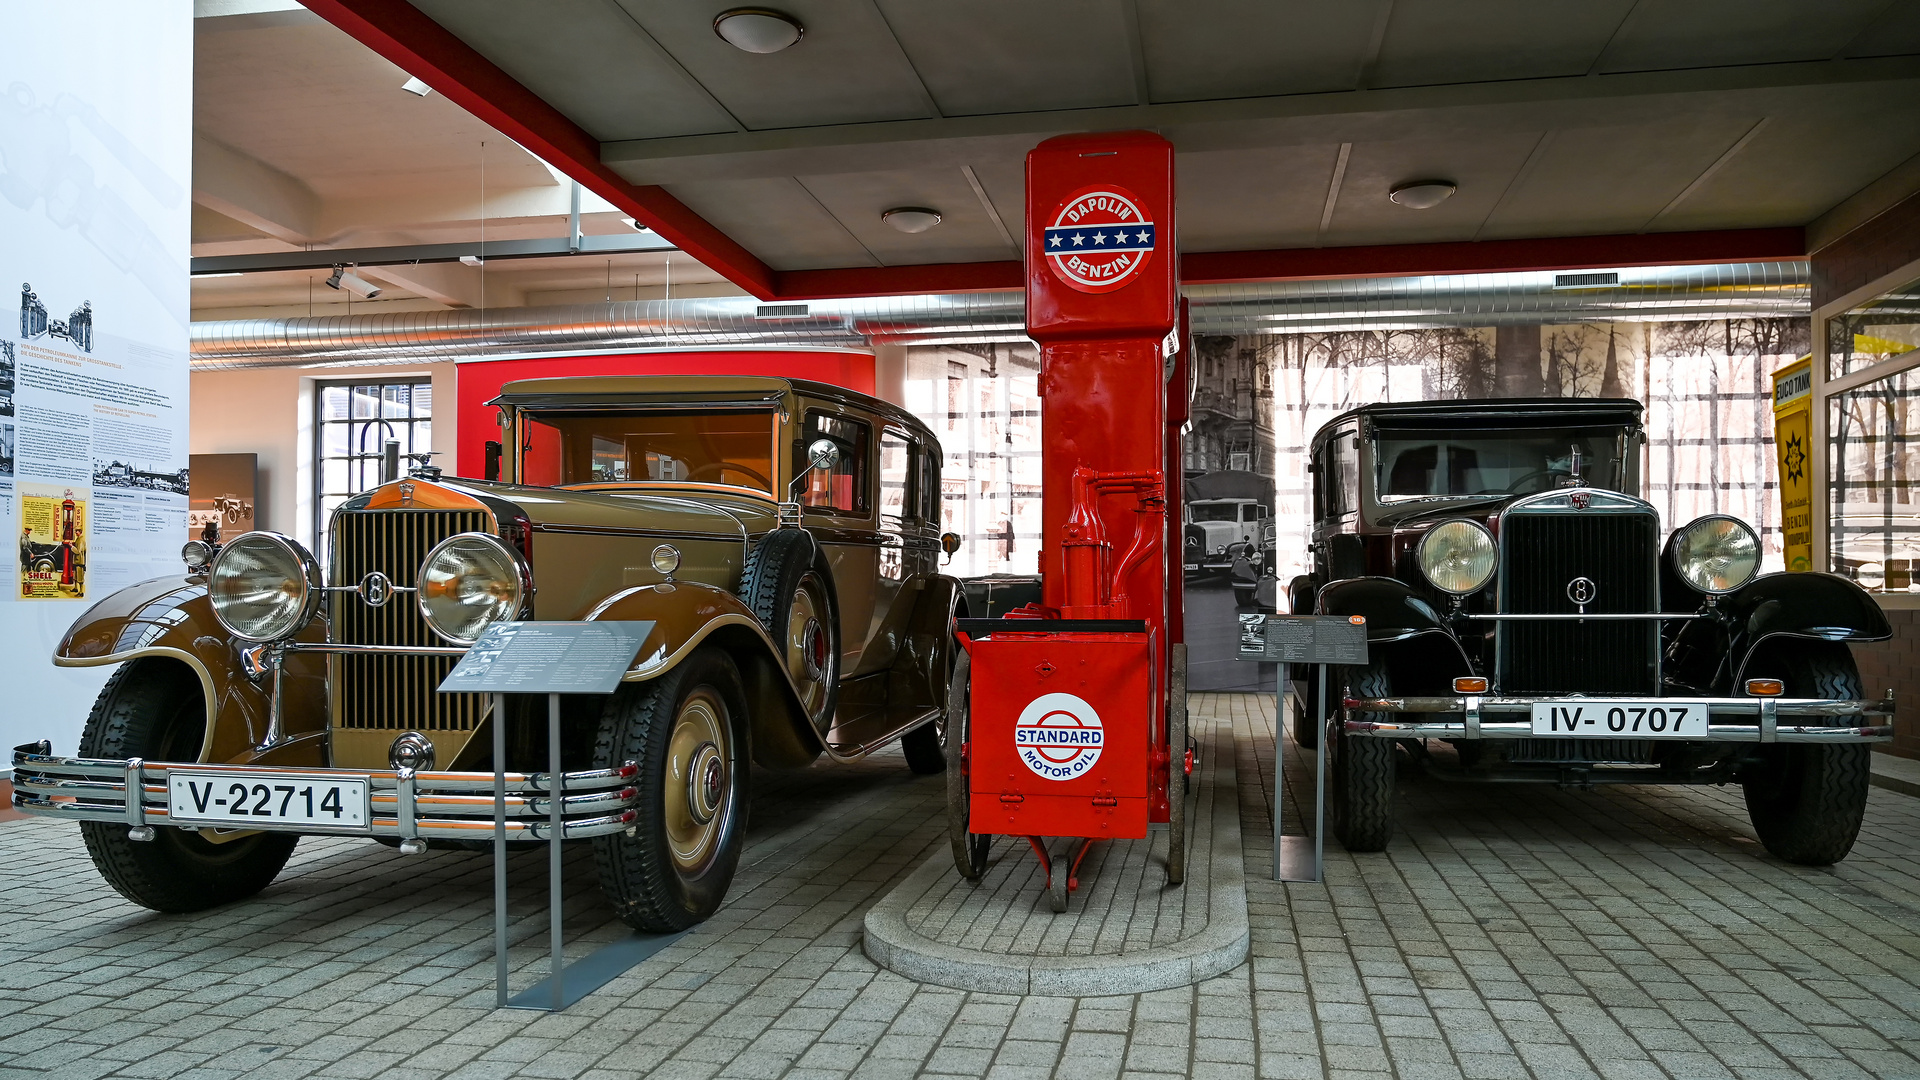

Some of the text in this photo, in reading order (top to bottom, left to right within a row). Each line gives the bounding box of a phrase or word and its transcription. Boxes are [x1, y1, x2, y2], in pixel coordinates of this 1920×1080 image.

[1067, 197, 1133, 223] DAPOLIN
[1067, 253, 1131, 278] BENZIN
[1776, 371, 1811, 401] EUCO TANK
[1787, 513, 1809, 530] BENZIN
[28, 571, 53, 579] SHELL
[370, 575, 383, 604] 8
[1576, 580, 1587, 601] 8
[1551, 707, 1689, 732] IV- 0707
[1017, 730, 1101, 743] STANDARD
[1024, 750, 1095, 777] MOTOR OIL
[188, 781, 344, 819] V-22714
